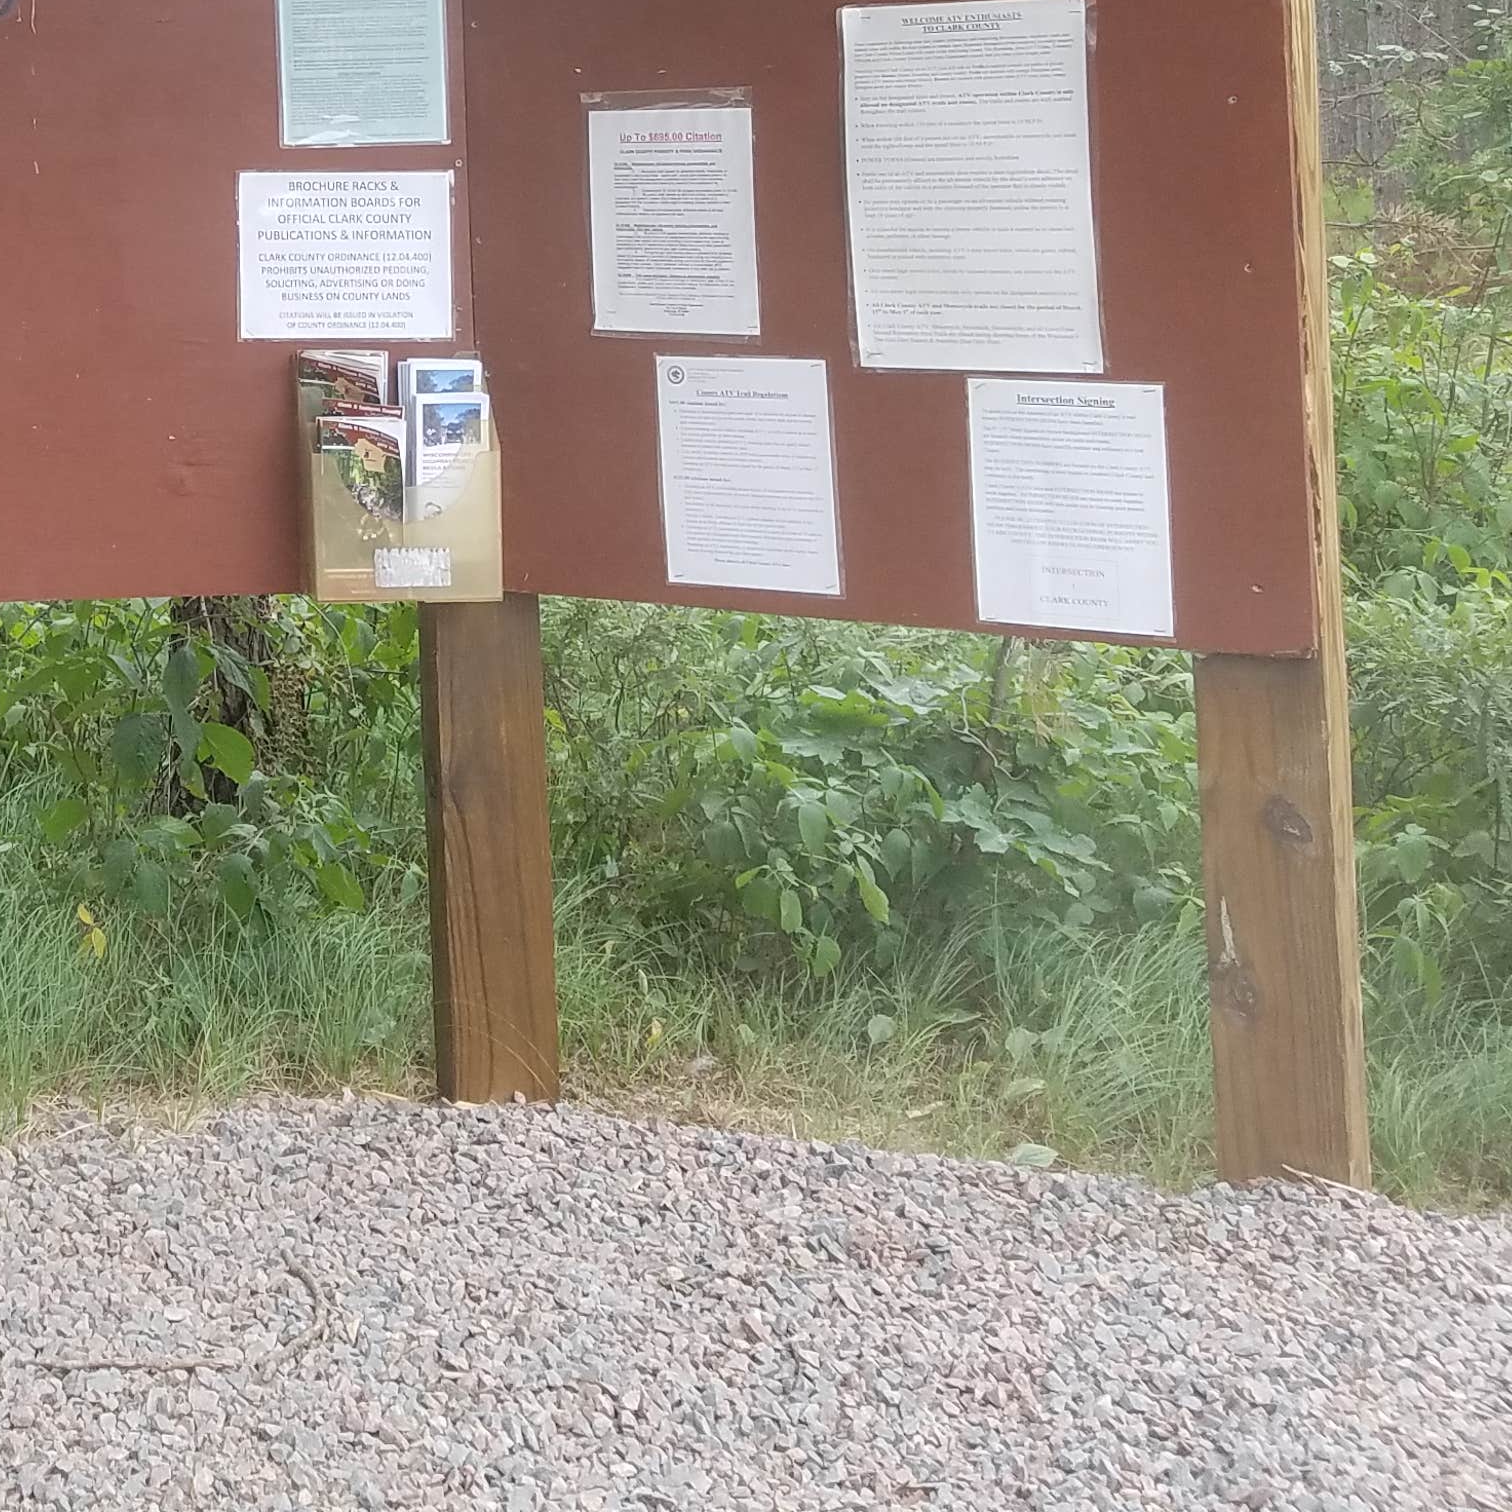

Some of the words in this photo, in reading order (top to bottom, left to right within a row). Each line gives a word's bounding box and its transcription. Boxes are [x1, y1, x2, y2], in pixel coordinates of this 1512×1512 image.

[620, 133, 632, 143] Up
[636, 133, 646, 143] To
[686, 132, 722, 142] Citation
[288, 180, 349, 191] BROCHURE
[351, 180, 387, 191] RACKS
[389, 180, 399, 191] &
[267, 197, 347, 208] INFORMATION
[350, 196, 396, 208] BOARDS
[398, 196, 421, 208] FOR
[277, 213, 326, 224] OFFICIAL
[328, 213, 362, 224] CLARK
[365, 213, 412, 224] COUNTY
[257, 229, 337, 240] PUBLICATIONS
[339, 229, 348, 240] &
[351, 229, 431, 240] INFORMATION
[257, 252, 286, 262] CLARK
[287, 252, 325, 262] COUNTY
[326, 252, 379, 261] ORDINANCE
[260, 265, 308, 275] PROHIBITS
[309, 265, 381, 275] UNAUTHORIZED
[382, 265, 429, 275] PEDDLING,
[264, 278, 317, 289] SOLICITING,
[319, 278, 378, 288] ADVERTISING
[380, 278, 394, 288] OR
[395, 278, 425, 288] DOING
[281, 291, 324, 301] BUSINESS
[325, 291, 340, 301] ON
[341, 291, 379, 301] COUNTY
[380, 291, 410, 301] LANDS
[1016, 394, 1073, 406] Intersection
[1077, 395, 1115, 408] Signing
